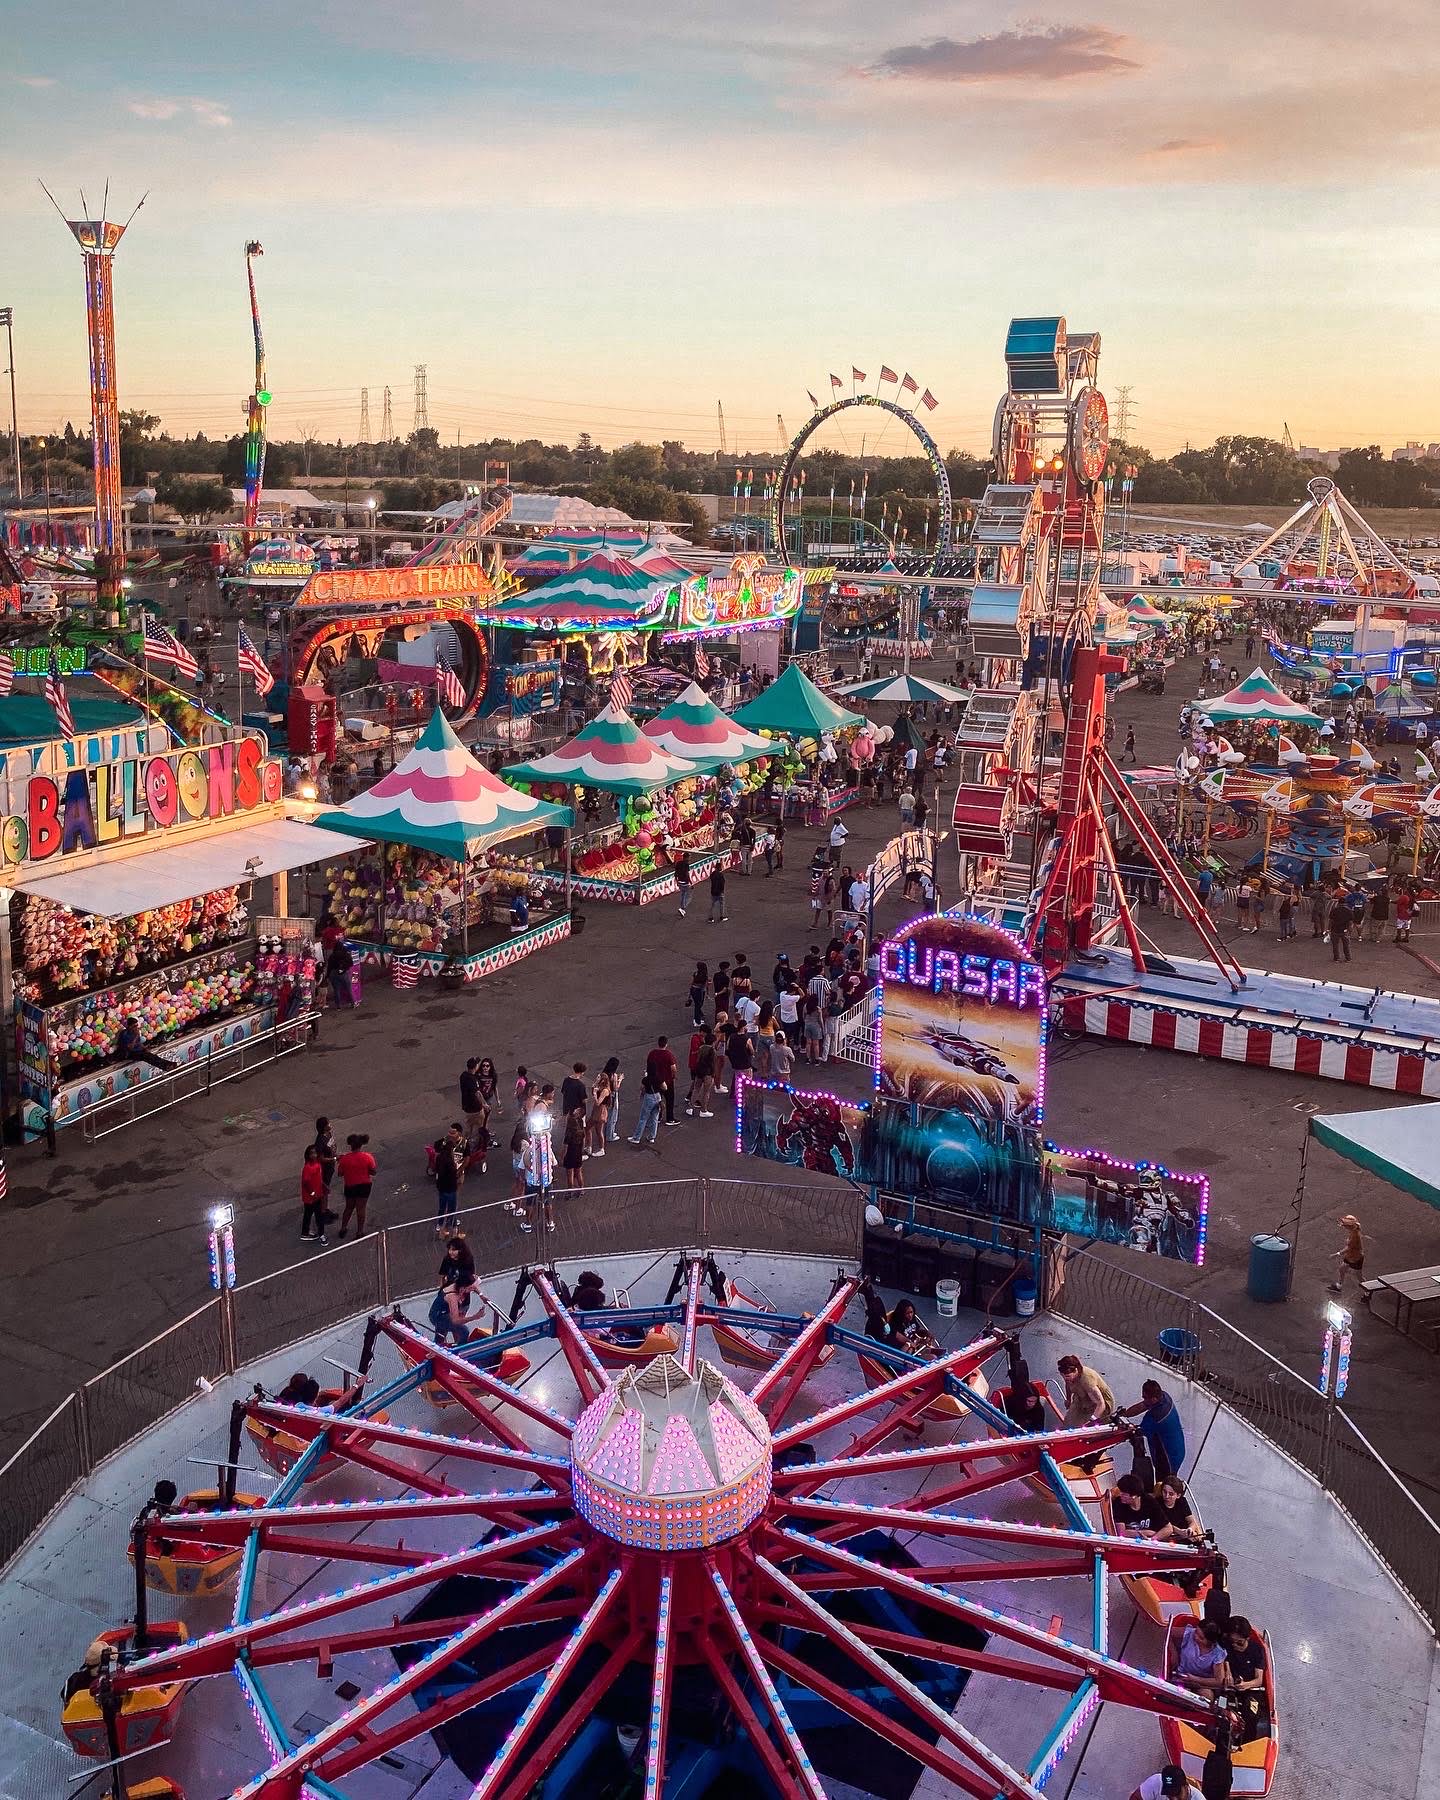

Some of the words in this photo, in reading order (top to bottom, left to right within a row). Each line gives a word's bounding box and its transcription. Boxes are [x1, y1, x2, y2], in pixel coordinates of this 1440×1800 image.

[314, 573, 399, 600] CRAZY
[412, 565, 478, 592] TRAIN
[310, 704, 318, 726] CRAZY
[310, 730, 318, 752] TRAIN
[28, 737, 263, 862] BALLOONS
[880, 937, 1047, 1010] QUASAR
[23, 1015, 39, 1034] WIN
[24, 1039, 40, 1059] BIG
